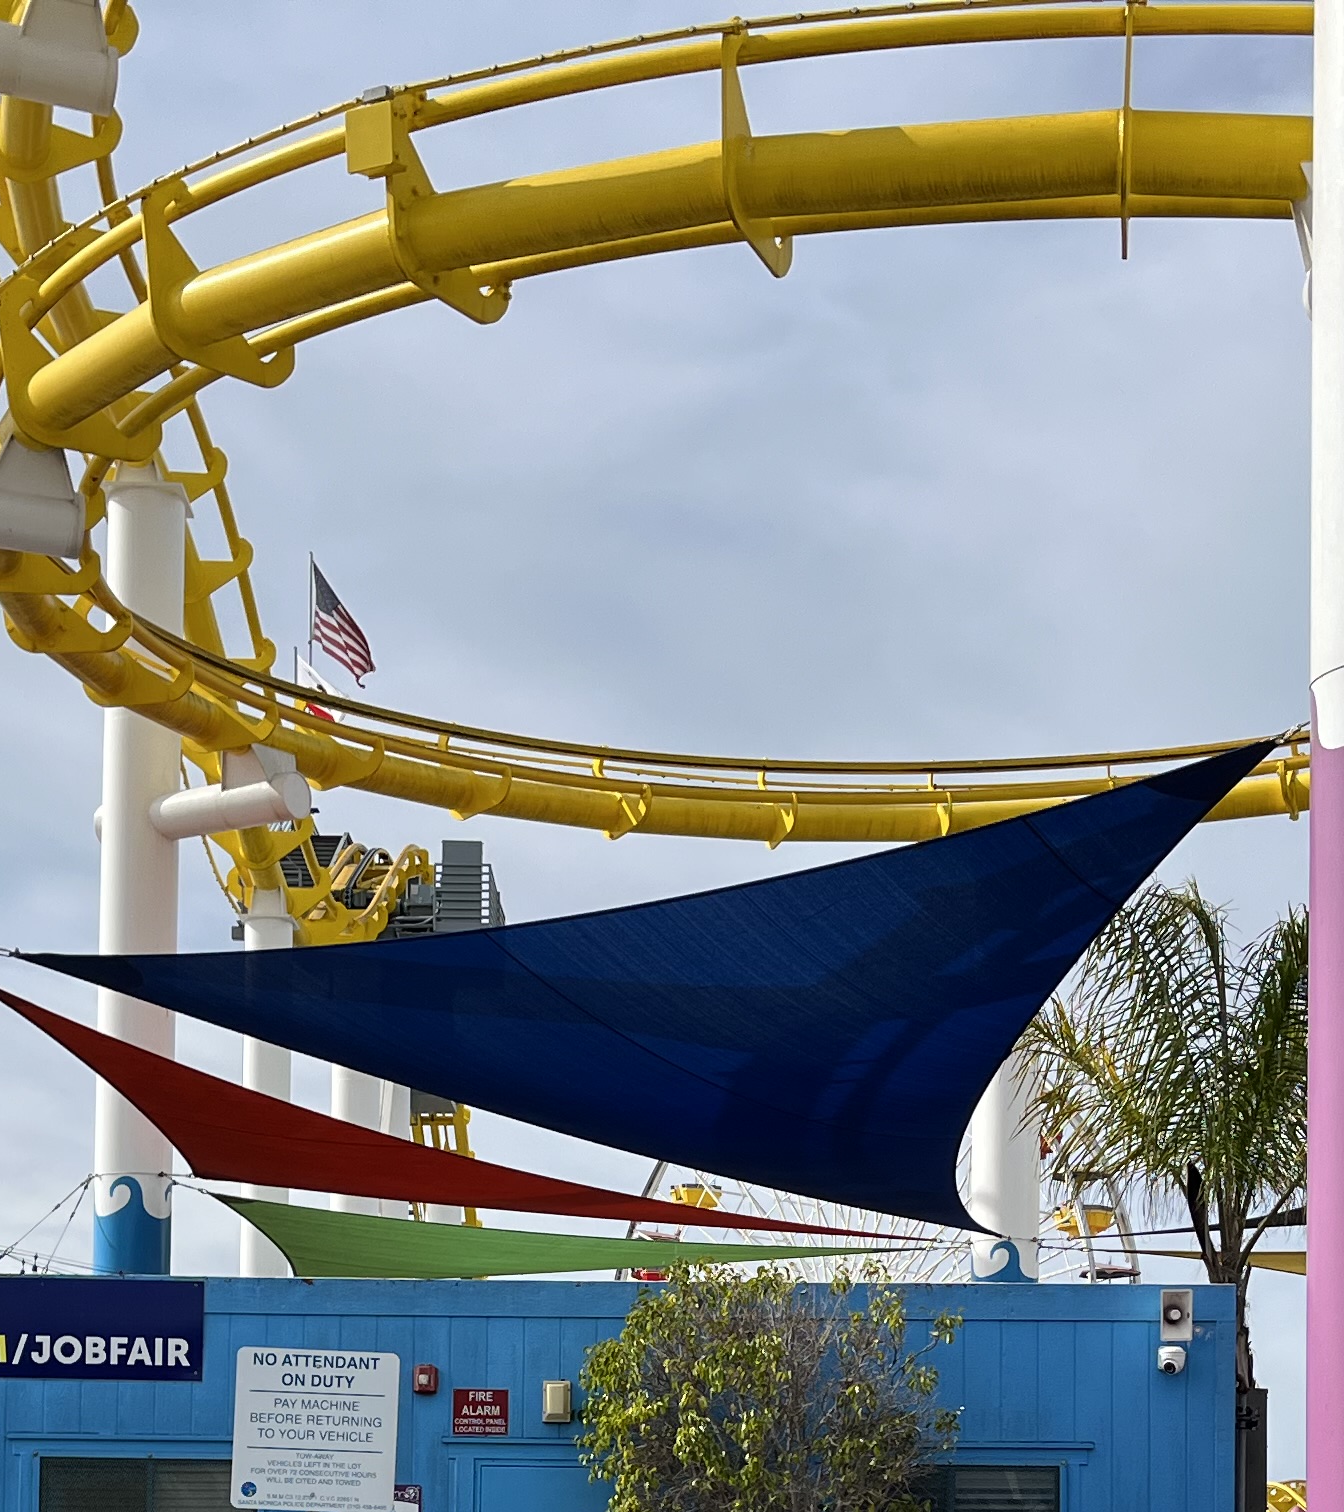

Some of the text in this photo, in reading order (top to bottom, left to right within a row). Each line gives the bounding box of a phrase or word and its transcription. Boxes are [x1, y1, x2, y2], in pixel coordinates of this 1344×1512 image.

[253, 1353, 380, 1370] NO ATTENDANT
[282, 1373, 355, 1388] ON DUTY
[468, 1391, 494, 1402] FIRE
[274, 1398, 359, 1412] PAY MACHINE
[461, 1405, 501, 1416] ALARM
[250, 1412, 382, 1428] BEFORE RETURNING
[257, 1428, 373, 1443] TO YOUR VEHICLE
[267, 1460, 303, 1468] VEHICLES
[250, 1467, 266, 1475] FOR
[298, 1469, 350, 1478] CONSECUTIVE
[351, 1471, 377, 1479] HOURS
[335, 1479, 361, 1487] TOWED
